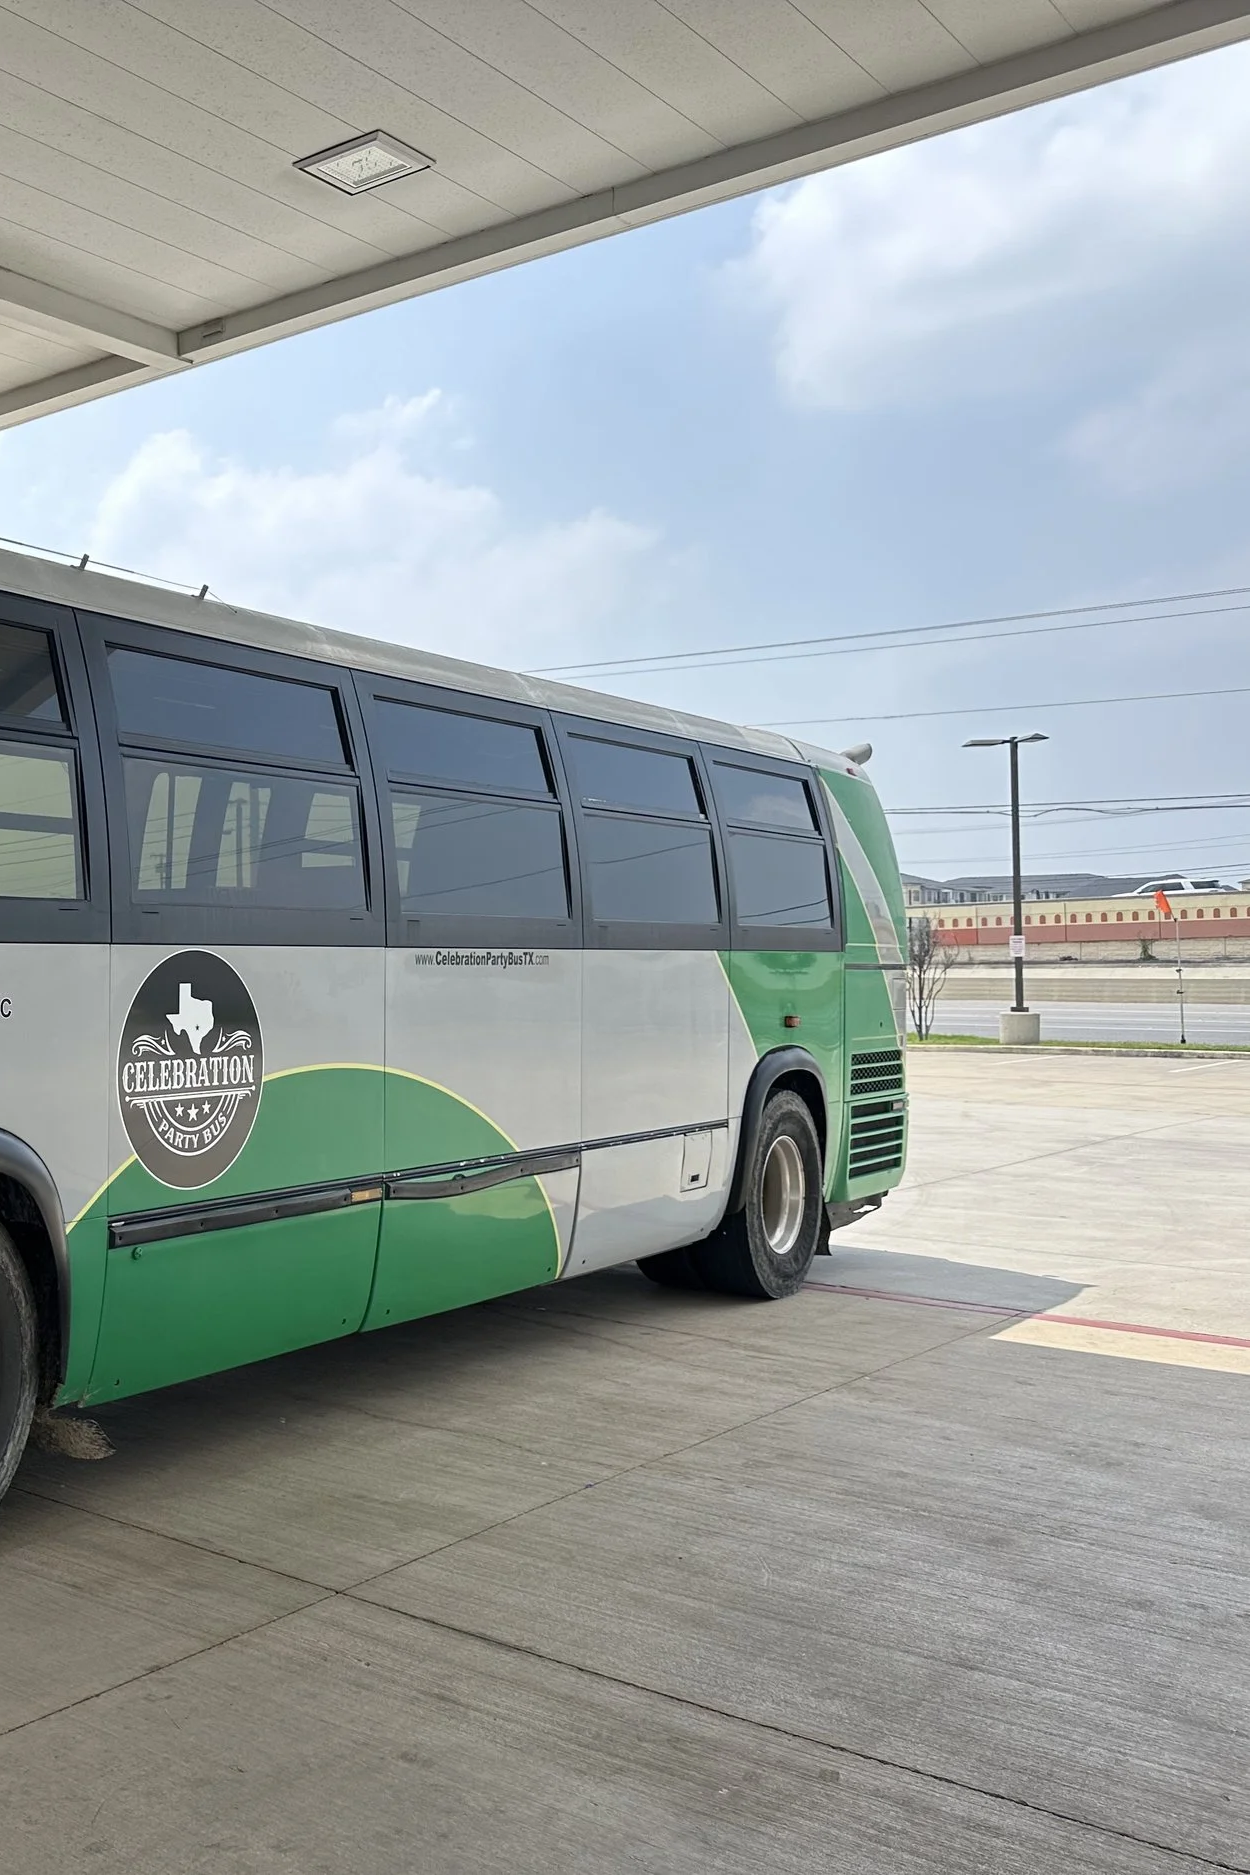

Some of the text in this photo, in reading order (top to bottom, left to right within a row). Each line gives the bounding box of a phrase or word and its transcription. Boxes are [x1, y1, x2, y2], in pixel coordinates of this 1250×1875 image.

[415, 951, 549, 969] www.CelebrationPartyBusTX.com
[122, 1055, 255, 1093] CELEBRATION
[158, 1112, 228, 1149] PARTY BUS
